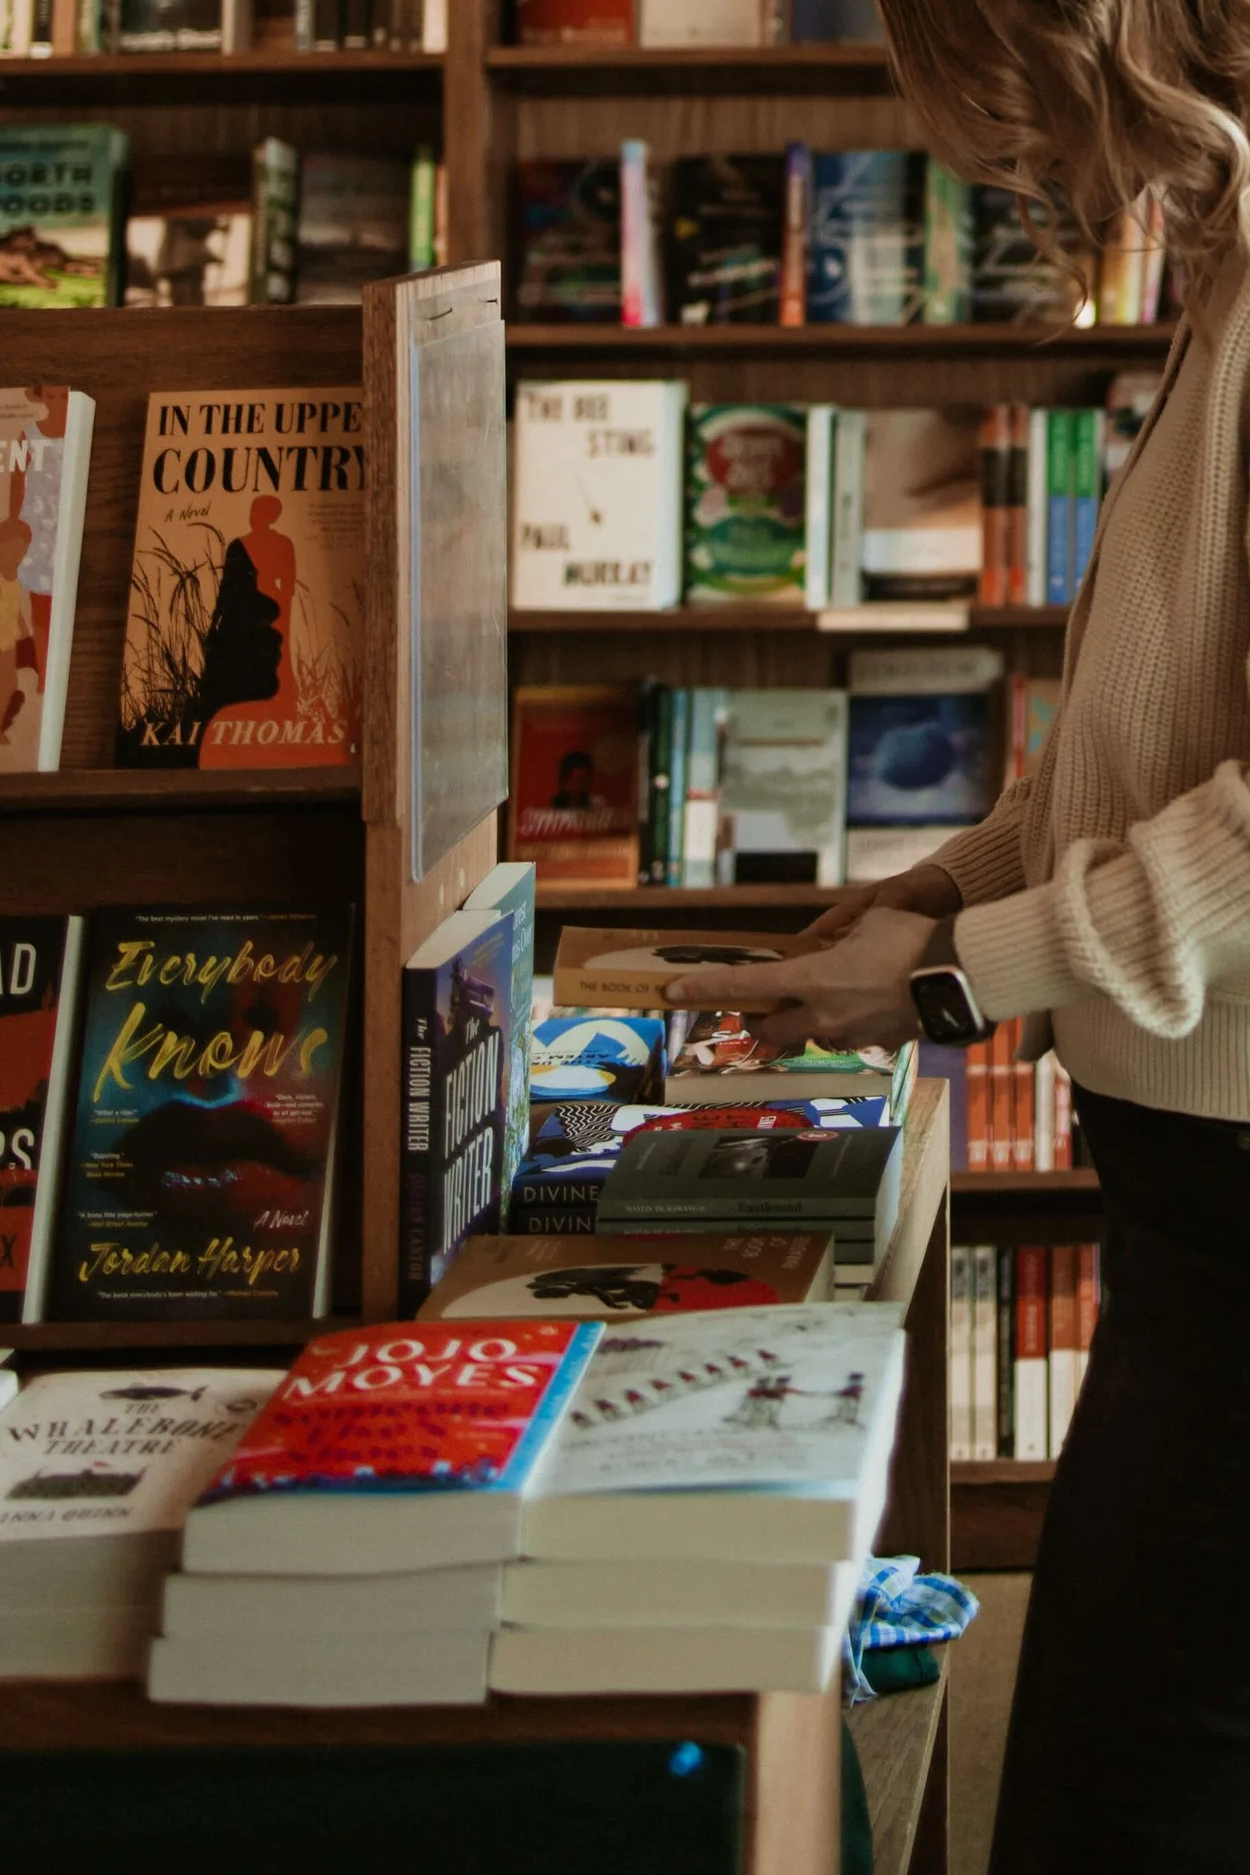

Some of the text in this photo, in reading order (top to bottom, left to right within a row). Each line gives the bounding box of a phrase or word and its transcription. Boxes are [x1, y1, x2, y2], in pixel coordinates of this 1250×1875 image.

[0, 161, 93, 188] ORTH
[0, 192, 95, 216] OODS
[157, 401, 362, 436] IN THE UPPE
[178, 501, 213, 522] Novel
[140, 719, 348, 746] KAI THOMAS
[105, 940, 338, 1005] Everybody
[415, 1017, 429, 1041] The
[464, 1016, 481, 1046] The
[92, 1001, 328, 1103] Knows
[408, 1045, 432, 1097] FICTION
[445, 1030, 500, 1161] FICTION
[407, 1100, 430, 1151] WRITER
[442, 1125, 494, 1257] WRITER
[523, 1184, 600, 1204] DIVINE
[528, 1215, 599, 1234] DIVIN
[77, 1236, 302, 1286] Jordan Harper
[335, 1338, 518, 1369] JOJO
[282, 1364, 541, 1401] MOYES
[124, 1402, 161, 1414] THE
[8, 1416, 247, 1443] WHALEBONE
[43, 1438, 182, 1456] THEATRE
[61, 1506, 133, 1522] QUINN
